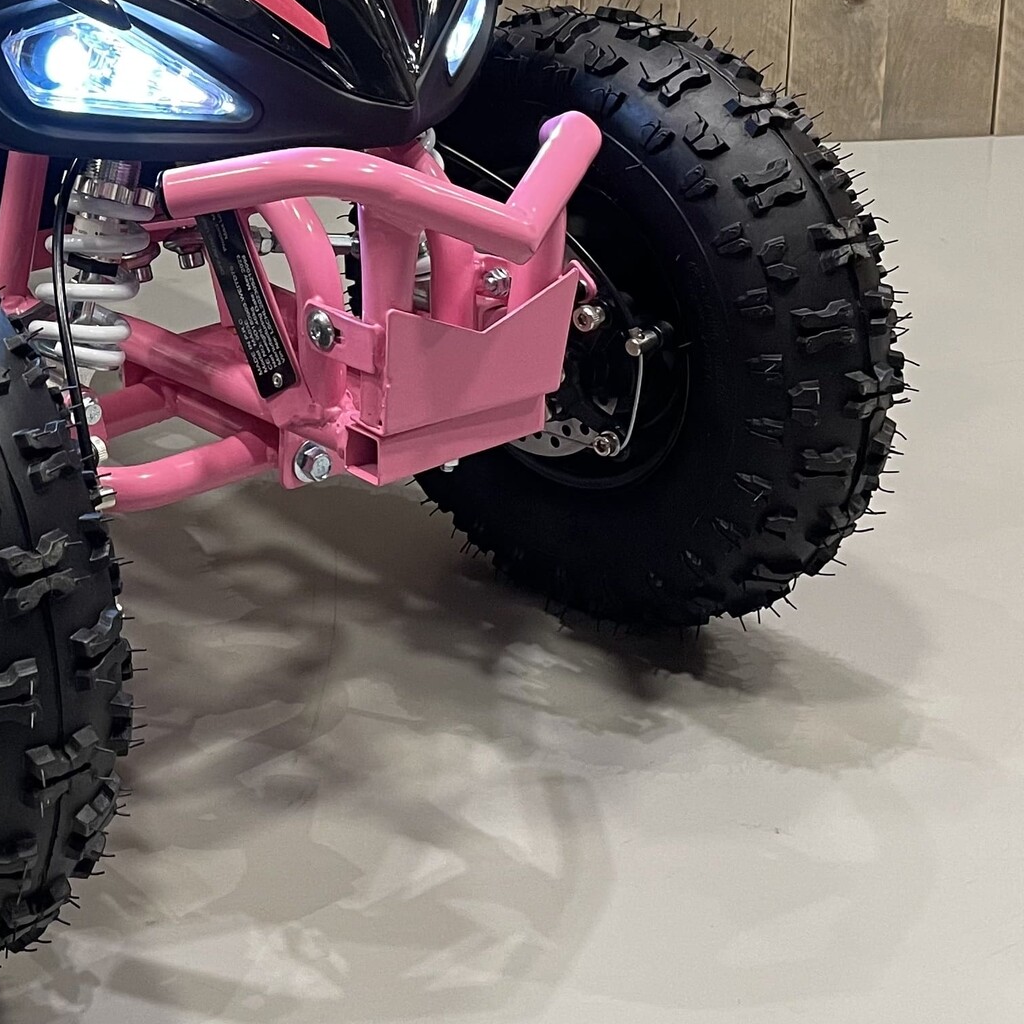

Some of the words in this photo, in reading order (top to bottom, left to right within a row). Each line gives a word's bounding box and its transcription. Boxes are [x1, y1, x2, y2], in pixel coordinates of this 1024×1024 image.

[242, 273, 251, 290] May
[246, 340, 252, 349] IN
[256, 312, 281, 365] Manufacturing
[250, 351, 263, 375] MADE
[264, 357, 273, 370] CE
[268, 353, 277, 368] Net
[277, 349, 286, 363] Vin
